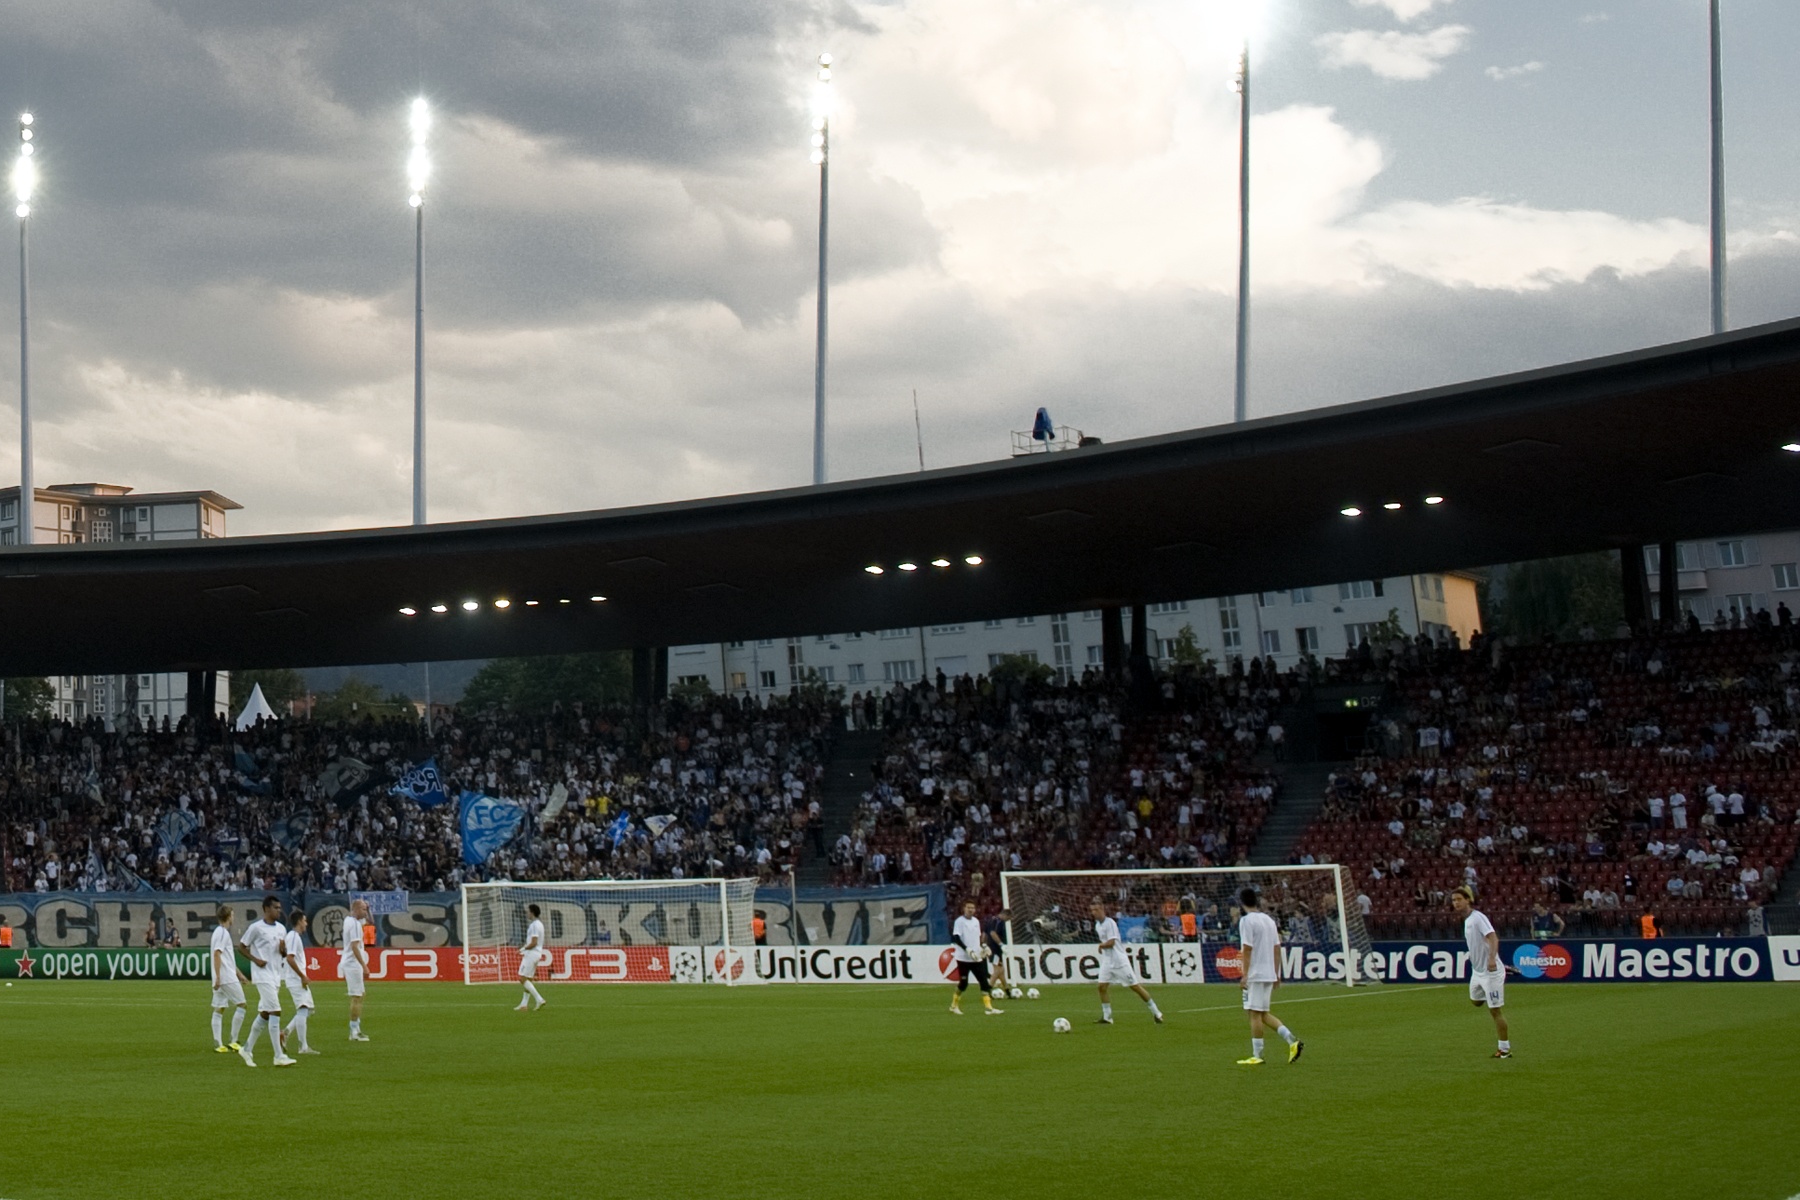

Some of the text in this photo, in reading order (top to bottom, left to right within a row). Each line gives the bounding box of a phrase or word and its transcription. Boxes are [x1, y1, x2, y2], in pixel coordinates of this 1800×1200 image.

[474, 804, 518, 825] FCZ
[42, 953, 210, 979] open your wor
[755, 949, 912, 980] UniCredit
[1006, 947, 1152, 980] niCreit
[1280, 945, 1470, 980] MasterCar
[1519, 955, 1567, 967] Maestro
[1583, 943, 1760, 978] Maestro
